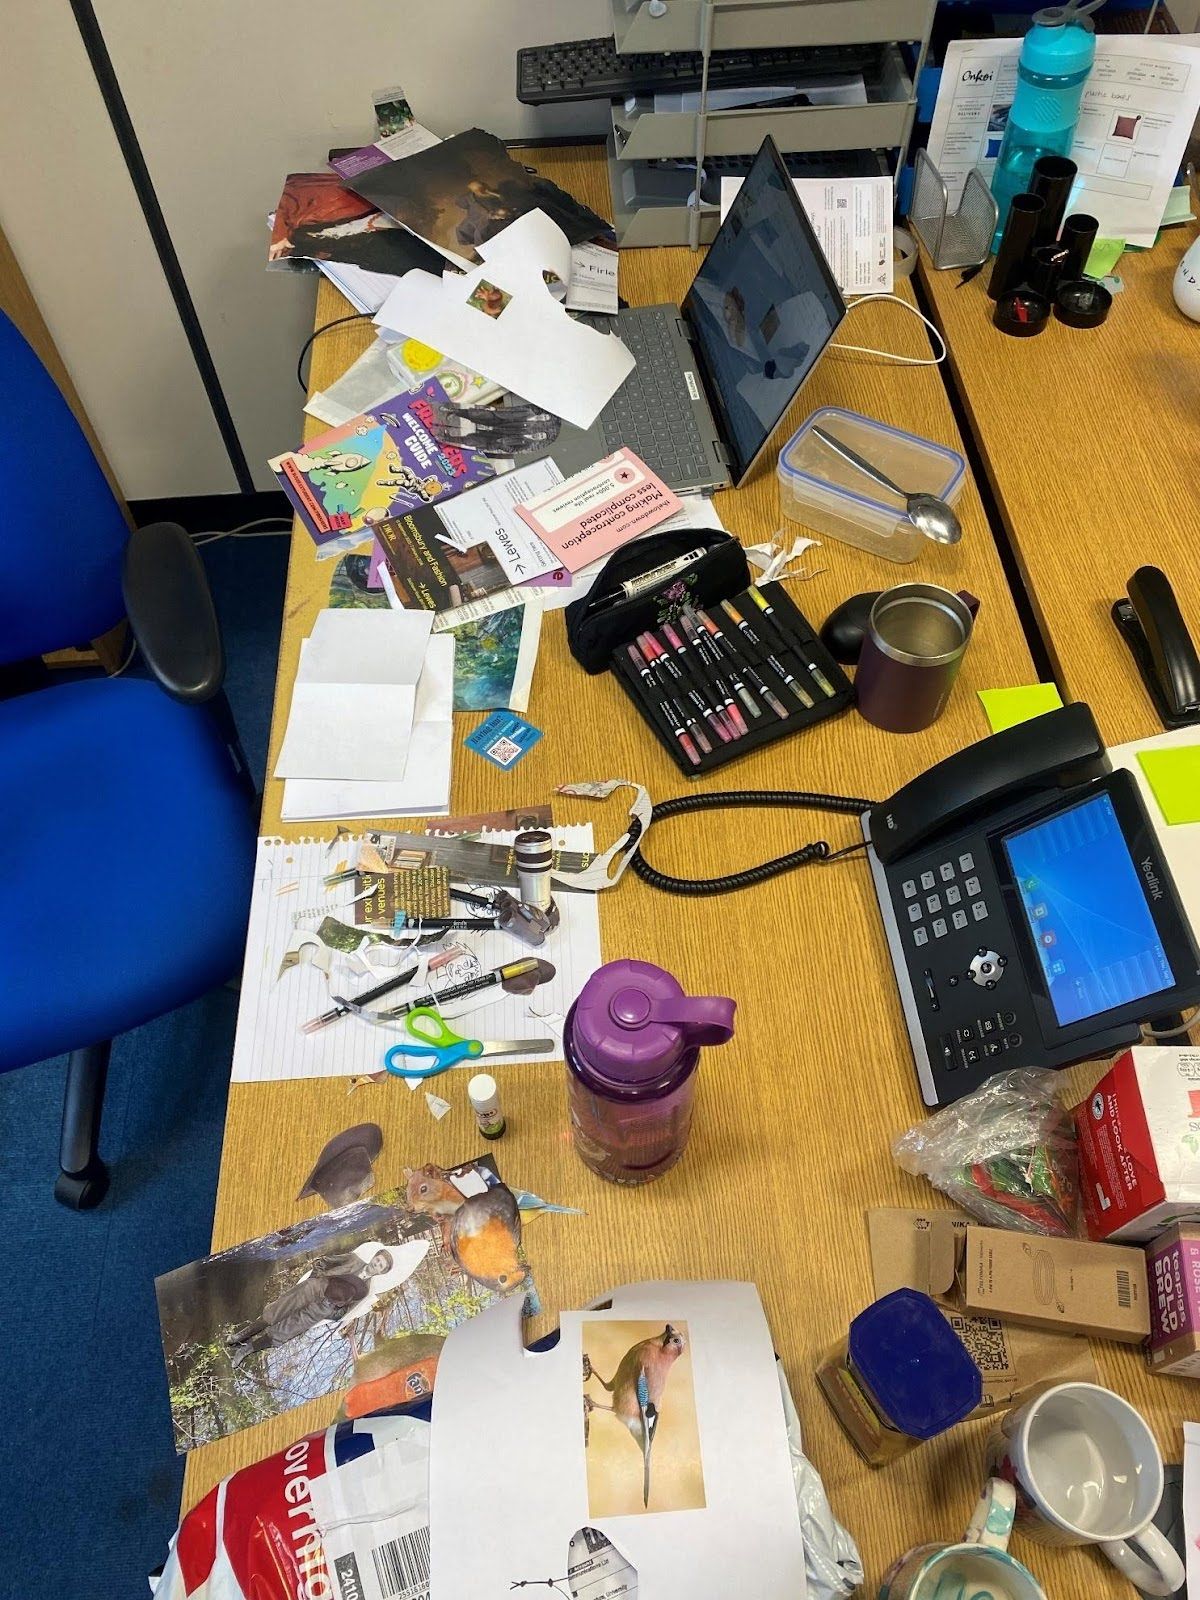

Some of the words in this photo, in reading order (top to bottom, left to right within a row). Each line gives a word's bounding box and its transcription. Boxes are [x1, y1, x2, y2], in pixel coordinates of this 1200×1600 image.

[589, 264, 615, 277] Firle
[402, 412, 438, 455] WELCOME
[403, 434, 433, 470] GUIDE
[438, 453, 456, 476] 2023
[625, 489, 662, 514] Making
[636, 482, 656, 496] less
[580, 492, 636, 527] complicated
[616, 499, 670, 533] thelowdown.com
[495, 528, 521, 564] Lewes
[562, 509, 626, 550] contraception
[402, 513, 428, 551] Bloomsbury
[422, 548, 435, 563] and
[429, 560, 448, 587] Fashion
[421, 588, 437, 609] Lewes
[377, 878, 385, 913] venues
[1140, 856, 1163, 900] Yealink
[1107, 1095, 1115, 1116] AND
[1112, 1119, 1123, 1150] LOOK
[1120, 1155, 1132, 1191] AFTER
[1126, 1156, 1137, 1187] LOVE
[1154, 1259, 1171, 1334] BREW
[1163, 1255, 1178, 1331] COLD
